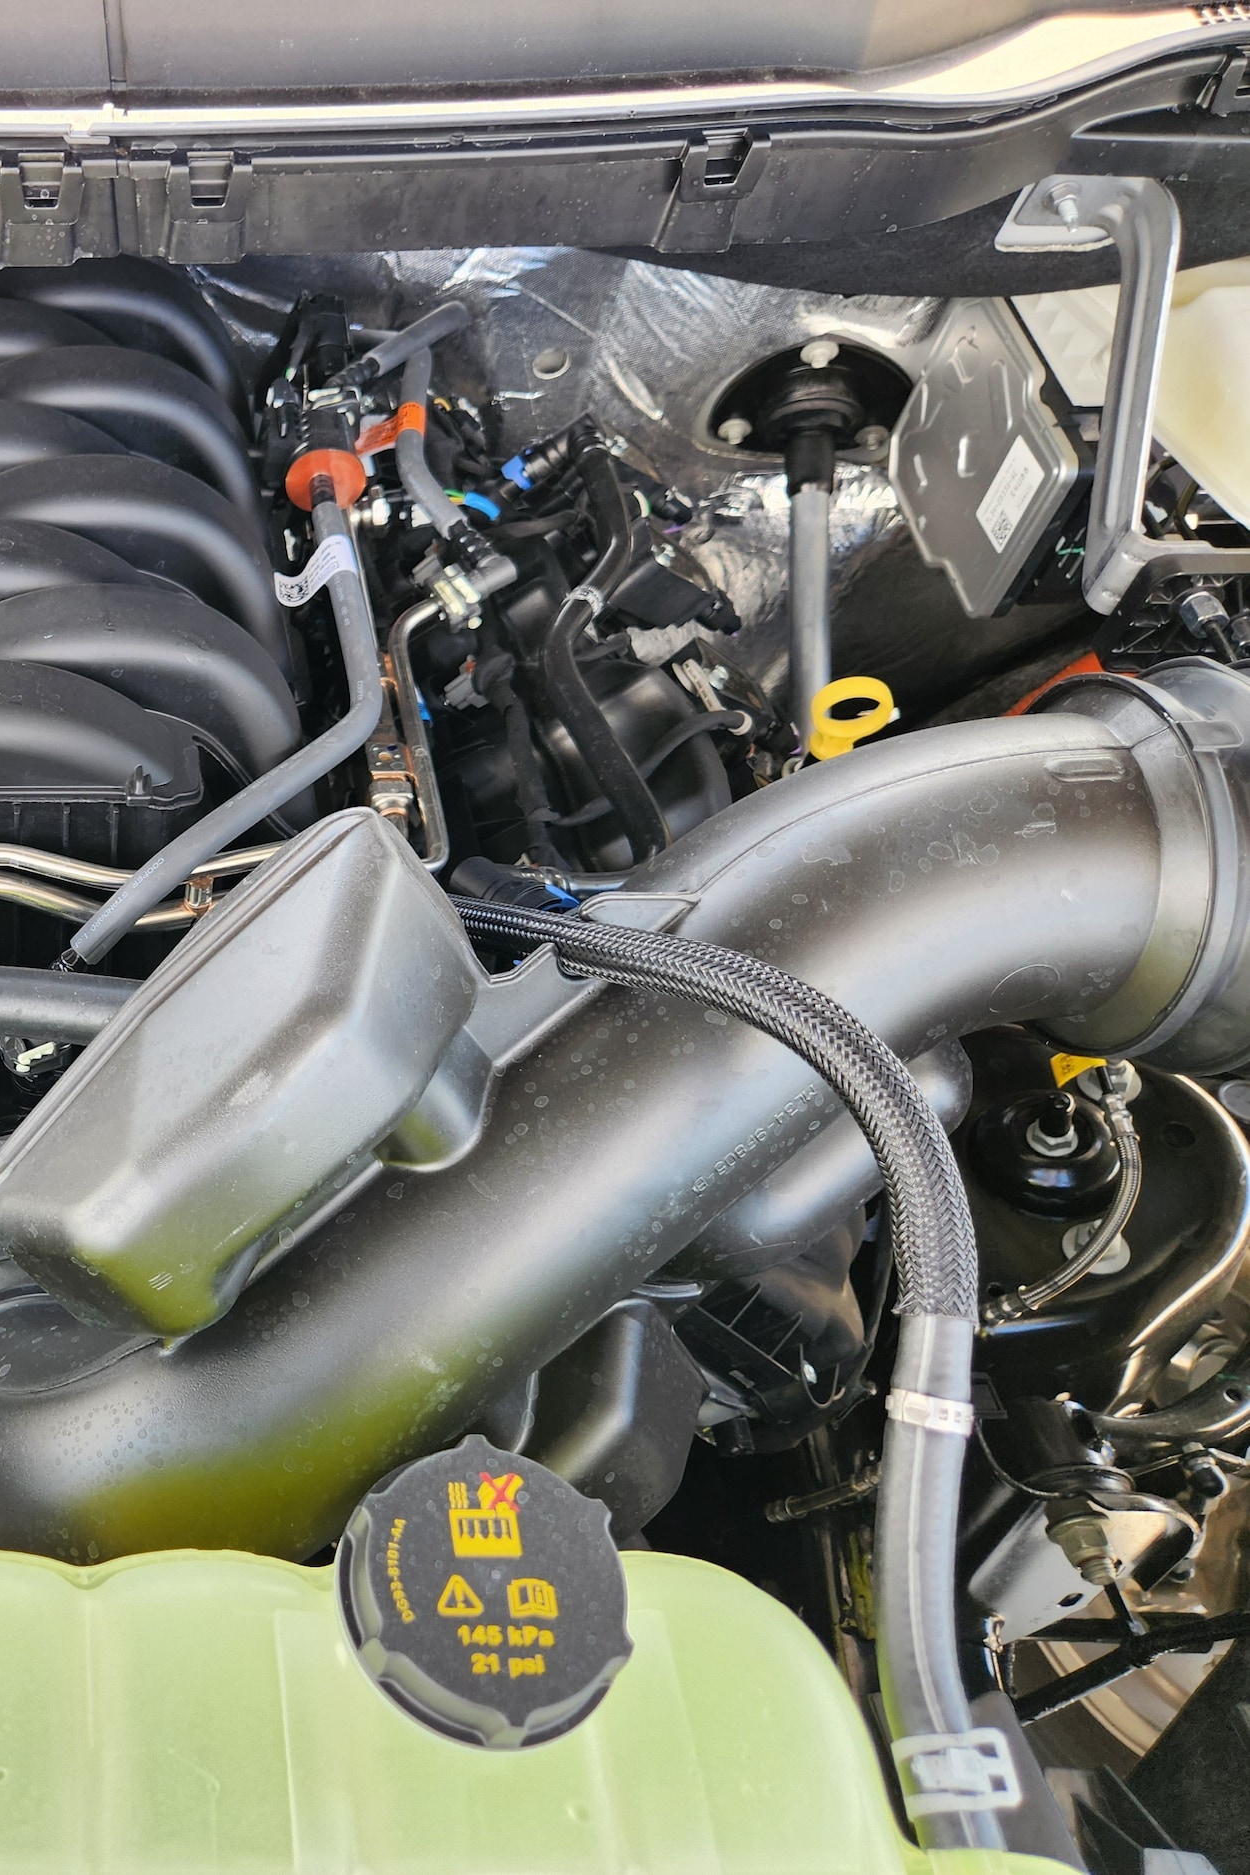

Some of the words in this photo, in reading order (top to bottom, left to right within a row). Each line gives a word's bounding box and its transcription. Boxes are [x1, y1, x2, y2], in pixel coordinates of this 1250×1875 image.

[132, 857, 165, 889] COOPER
[90, 891, 129, 932] STANDARD
[457, 1624, 503, 1647] 145
[507, 1625, 555, 1647] kPa
[471, 1652, 501, 1674] 21
[508, 1653, 546, 1679] psi
